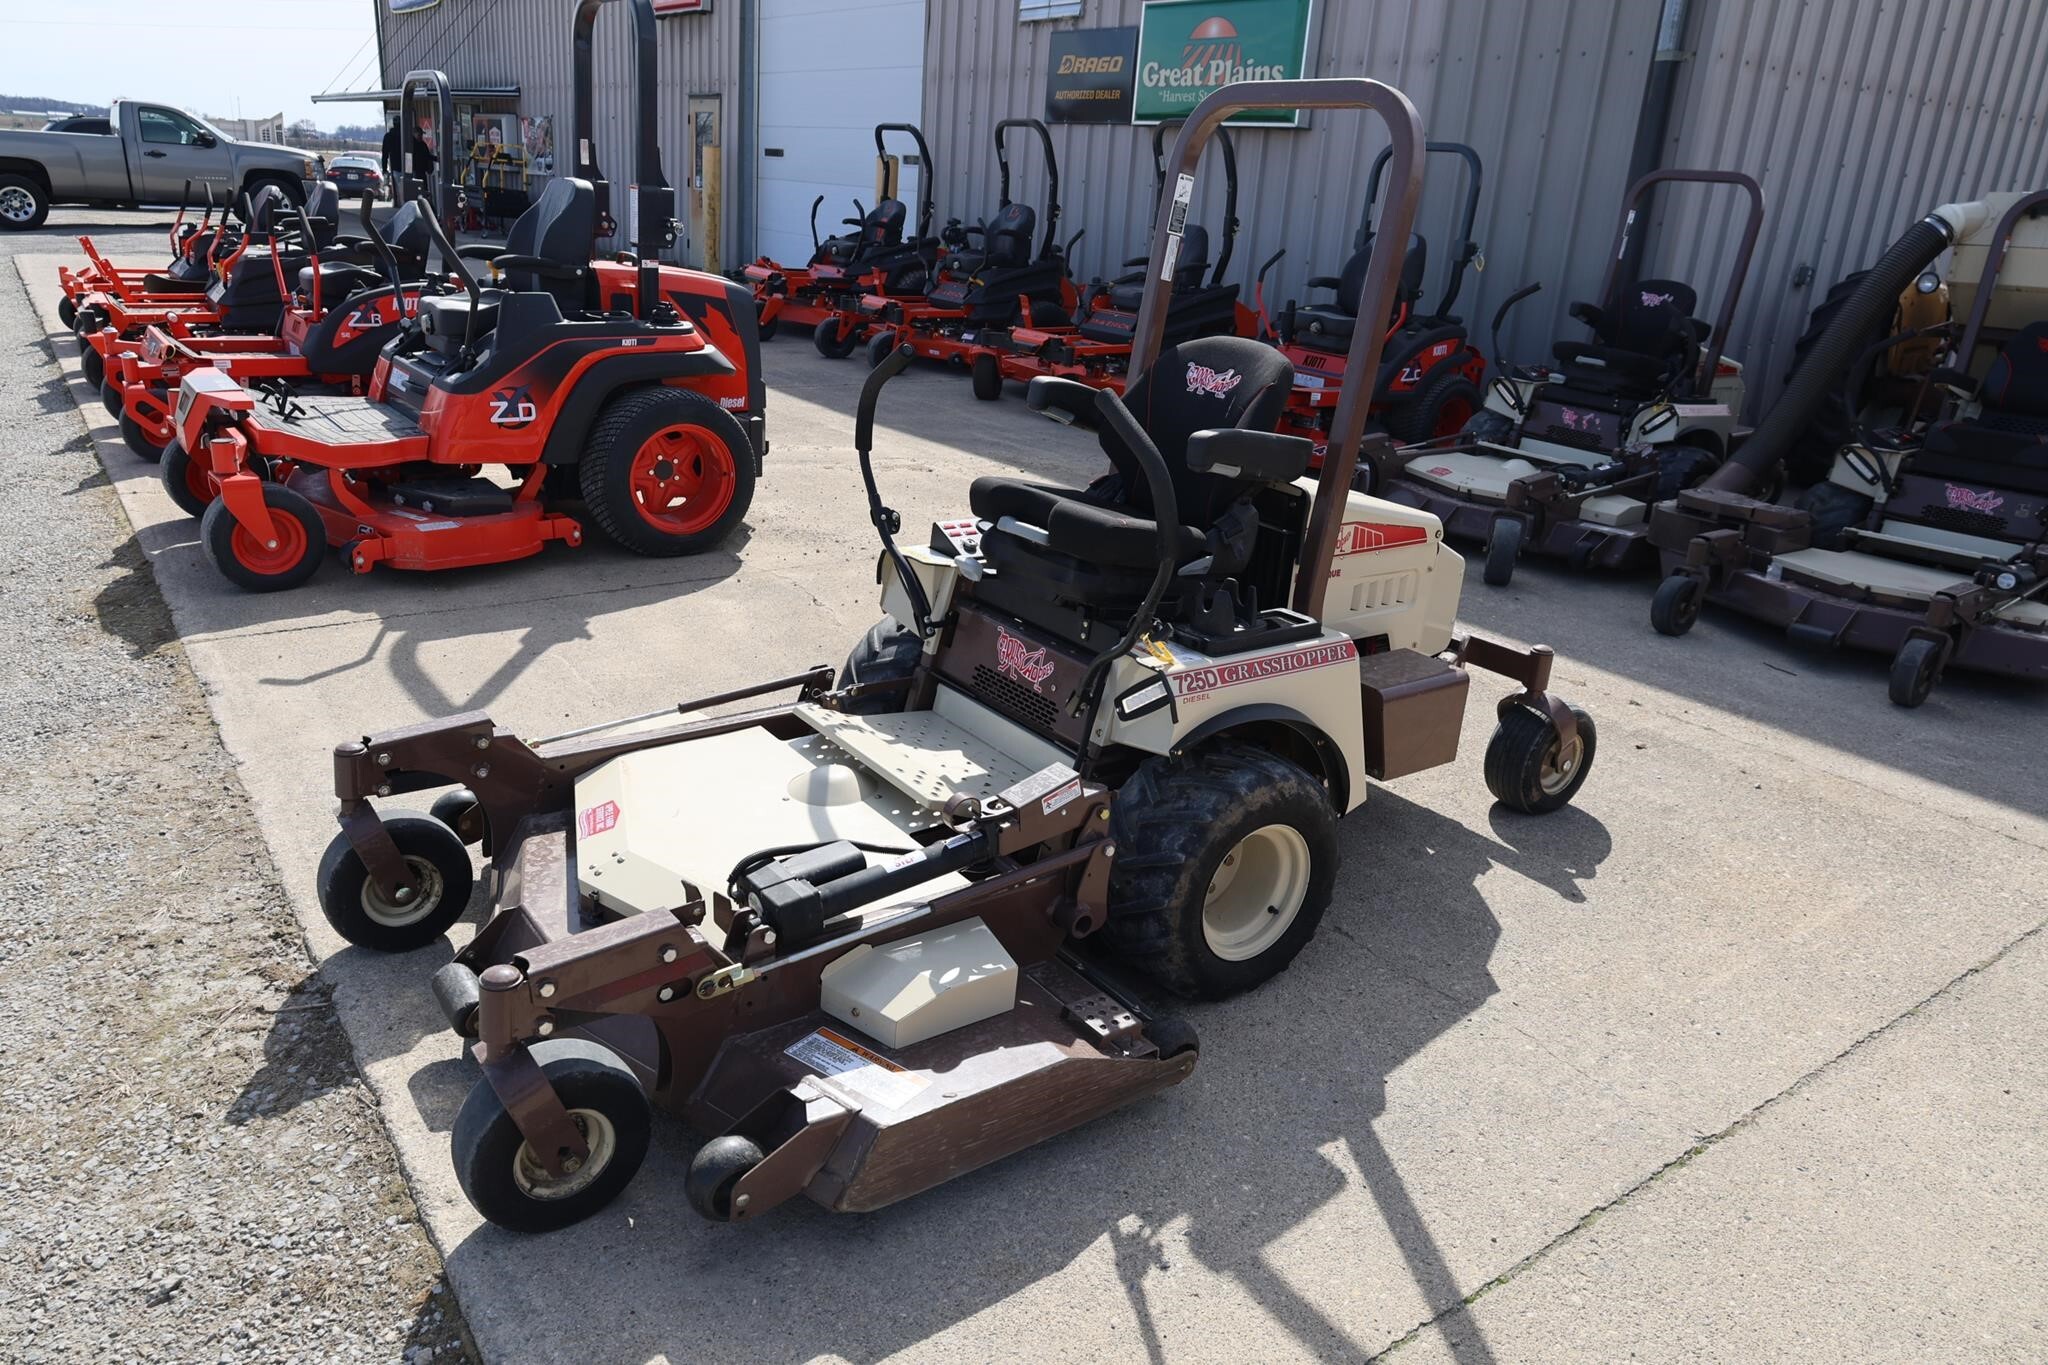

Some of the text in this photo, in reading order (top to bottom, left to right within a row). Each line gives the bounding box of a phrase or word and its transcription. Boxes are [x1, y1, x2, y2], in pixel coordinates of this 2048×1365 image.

[1057, 55, 1123, 74] DRAGO
[1142, 58, 1285, 88] Great Plains
[1055, 89, 1121, 100] AUTHORIZED DEALER
[621, 337, 638, 347] KIOTI
[1432, 344, 1448, 357] KIOTI
[1302, 354, 1328, 370] KIOTI
[720, 395, 746, 409] Diesel
[1172, 644, 1348, 694] 725D GRASSHOPPER
[1182, 692, 1211, 705] DIESEL
